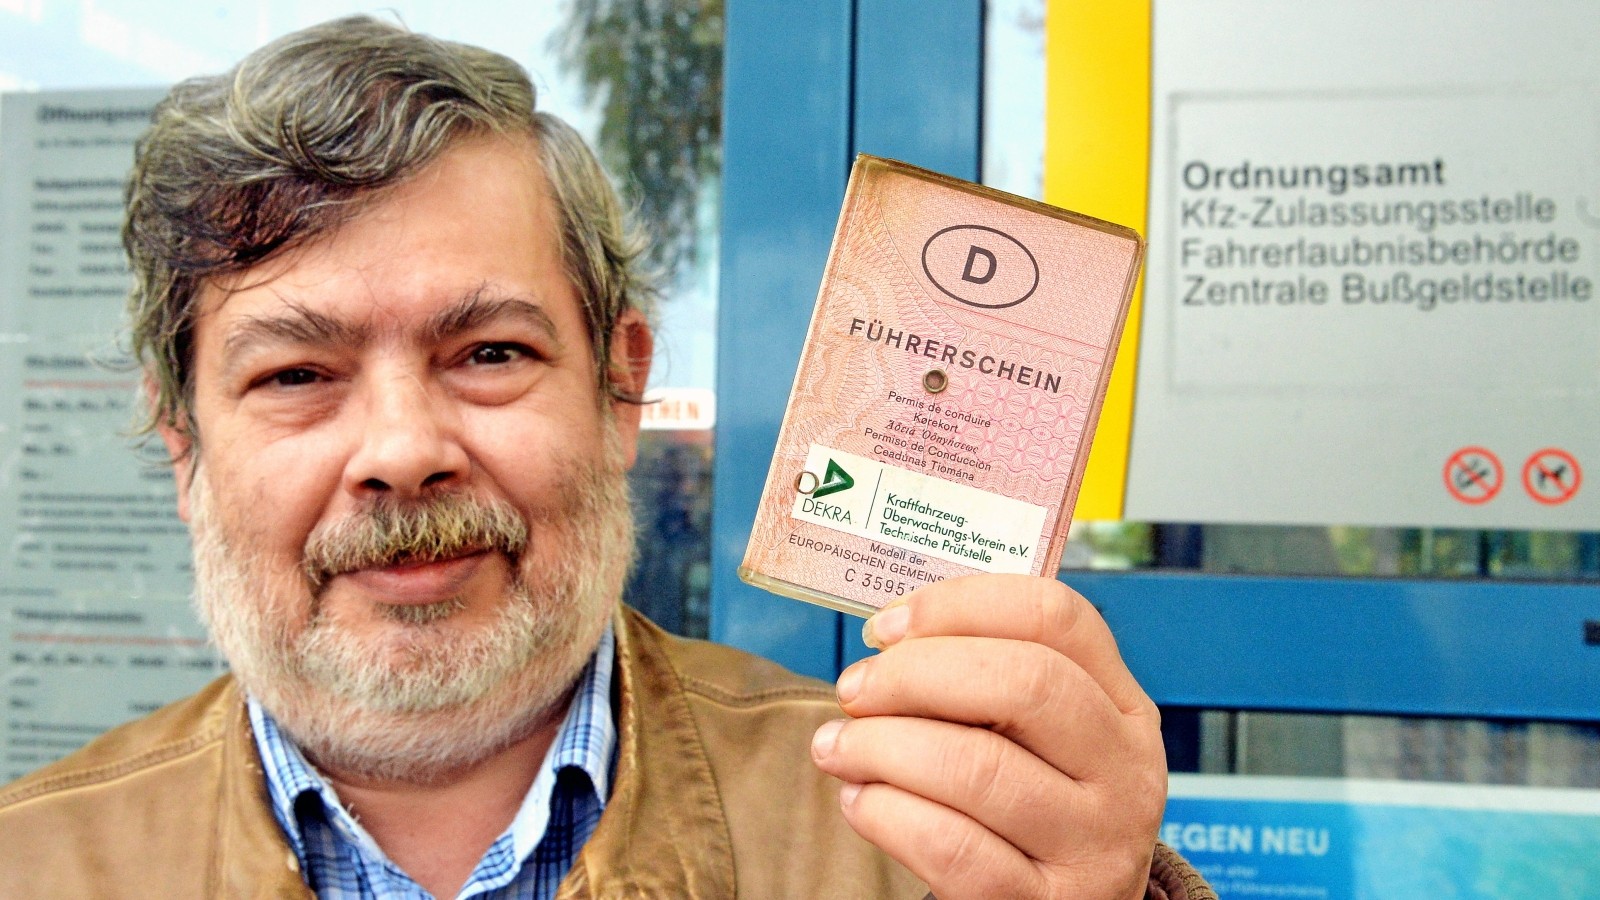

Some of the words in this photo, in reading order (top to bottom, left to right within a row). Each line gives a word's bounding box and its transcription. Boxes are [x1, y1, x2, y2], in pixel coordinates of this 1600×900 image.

[1182, 157, 1445, 195] Ordnungsamt
[1181, 191, 1557, 233] Kfz-Zulassungsstelle
[961, 244, 998, 285] D
[1180, 233, 1580, 268] Fahrerlaubnisbehörde
[1182, 275, 1329, 306] Zentrale
[1341, 271, 1593, 312] Bußgeldstelle
[849, 318, 1062, 393] FÜHRERSCHEIN
[887, 390, 924, 409] Permis
[927, 402, 942, 414] de
[944, 409, 992, 428] conduire
[913, 412, 959, 433] Kørekort
[864, 427, 907, 448] Permiso
[910, 441, 925, 452] de
[928, 446, 992, 472] Conducción
[873, 445, 927, 468] Ceadúnas
[931, 460, 975, 481] Tiomána
[802, 498, 852, 525] DEKRA
[886, 493, 969, 528] Kraftfahrzeug-
[880, 522, 939, 549] Technische
[942, 539, 992, 564] Prüfstelle
[883, 507, 1006, 552] Überwachungs-Verein
[1009, 544, 1029, 558] e.V.
[788, 534, 886, 570] EUROPÄISCHEN
[870, 543, 906, 561] Modell
[909, 555, 928, 567] der
[845, 568, 857, 583] C
[1260, 825, 1330, 857] NEU
